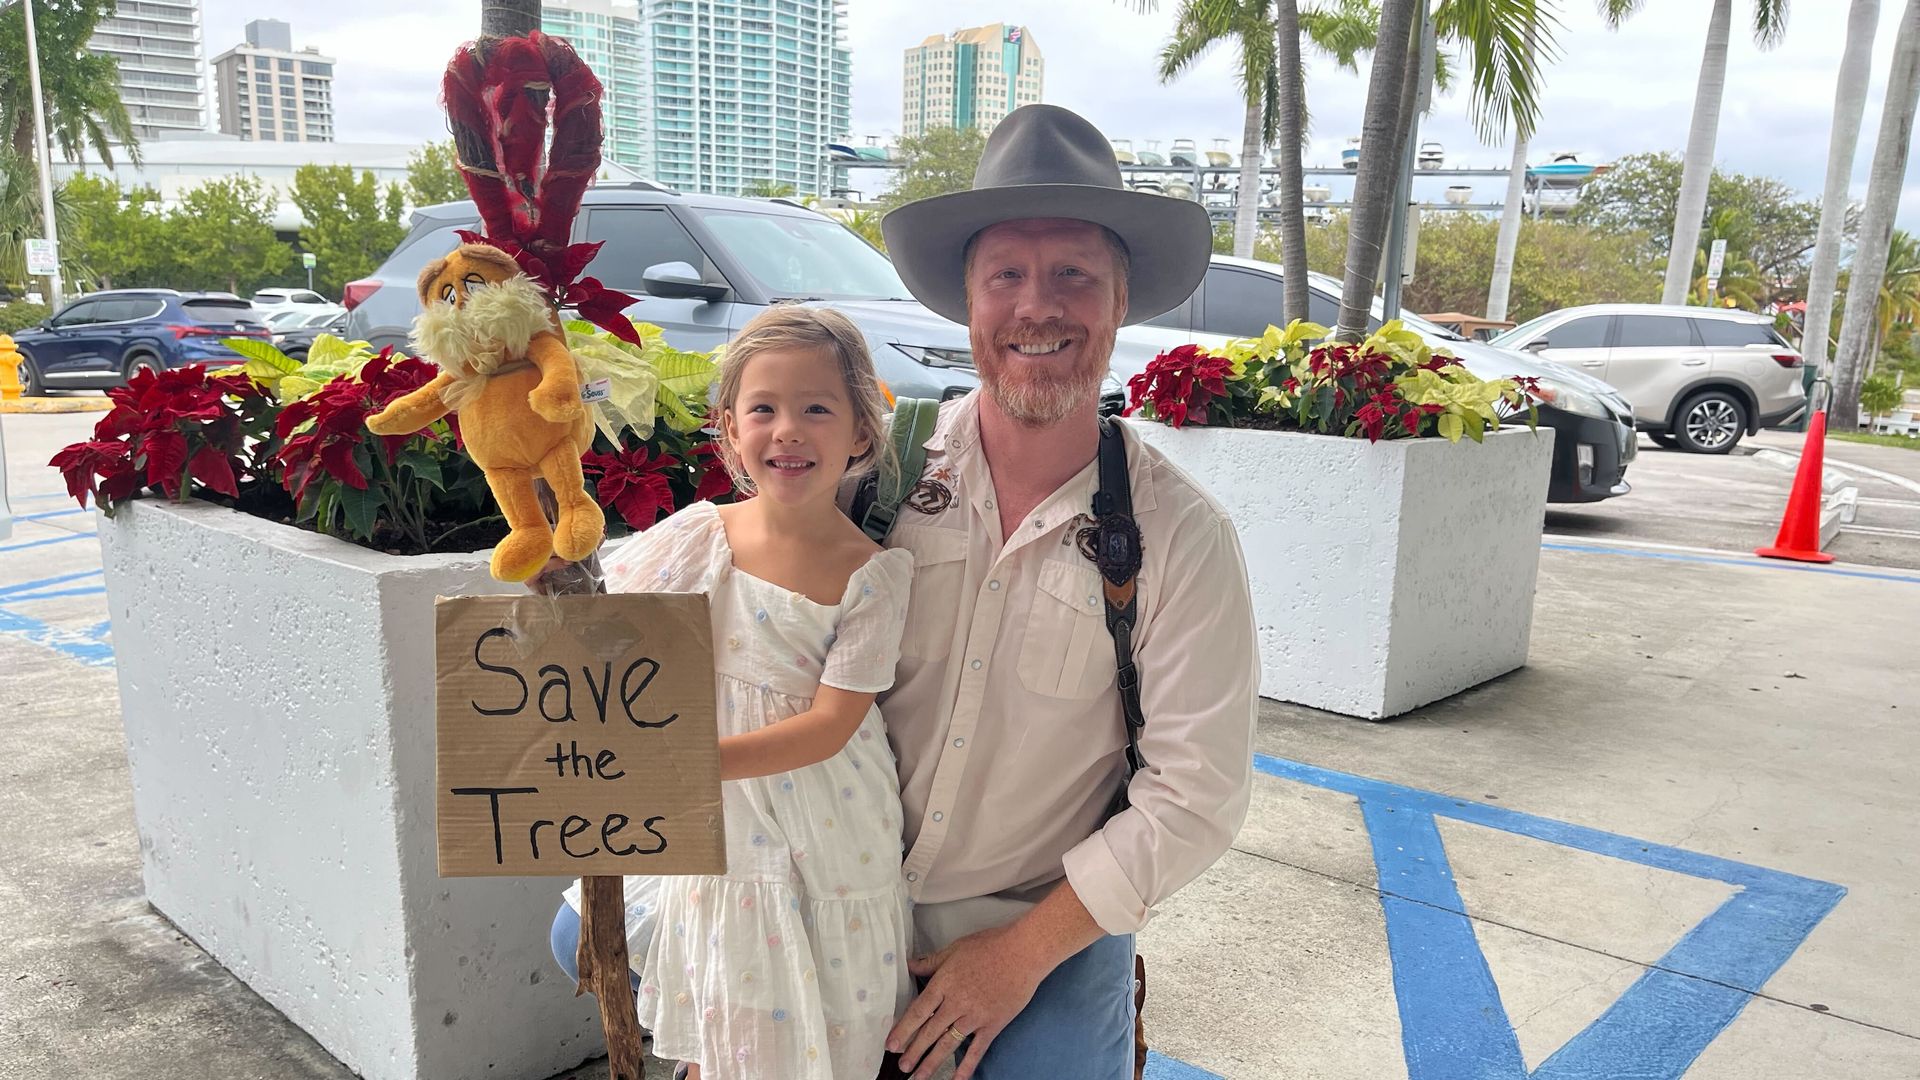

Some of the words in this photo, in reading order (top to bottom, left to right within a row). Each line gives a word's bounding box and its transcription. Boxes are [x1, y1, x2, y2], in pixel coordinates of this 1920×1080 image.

[472, 627, 679, 728] Save
[545, 740, 626, 780] the
[450, 787, 668, 864] Trees
